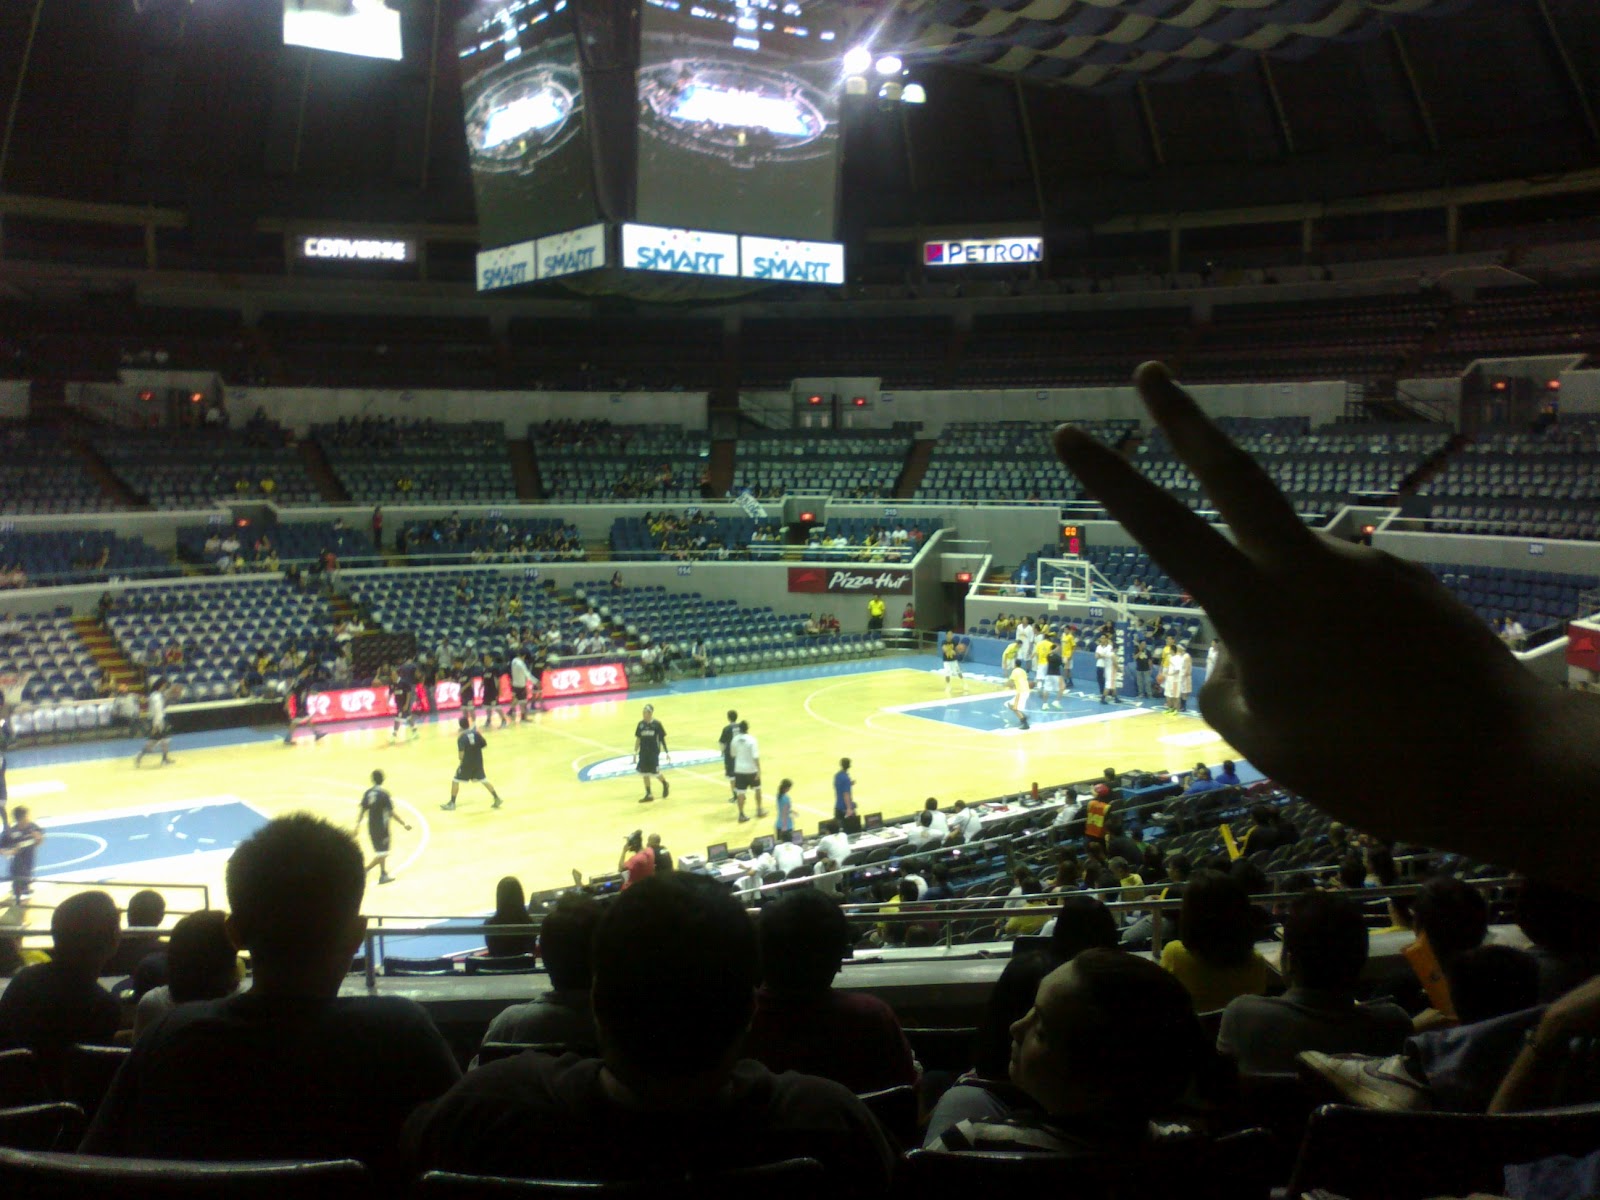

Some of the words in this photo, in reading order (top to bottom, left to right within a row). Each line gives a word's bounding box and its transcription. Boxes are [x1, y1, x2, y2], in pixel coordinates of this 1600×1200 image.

[543, 245, 596, 278] SMART
[637, 246, 725, 274] SMART
[948, 242, 1042, 262] PETRON
[483, 261, 528, 290] SMART
[753, 256, 831, 282] SMART
[828, 571, 873, 590] Pizza
[875, 572, 911, 589] Hut
